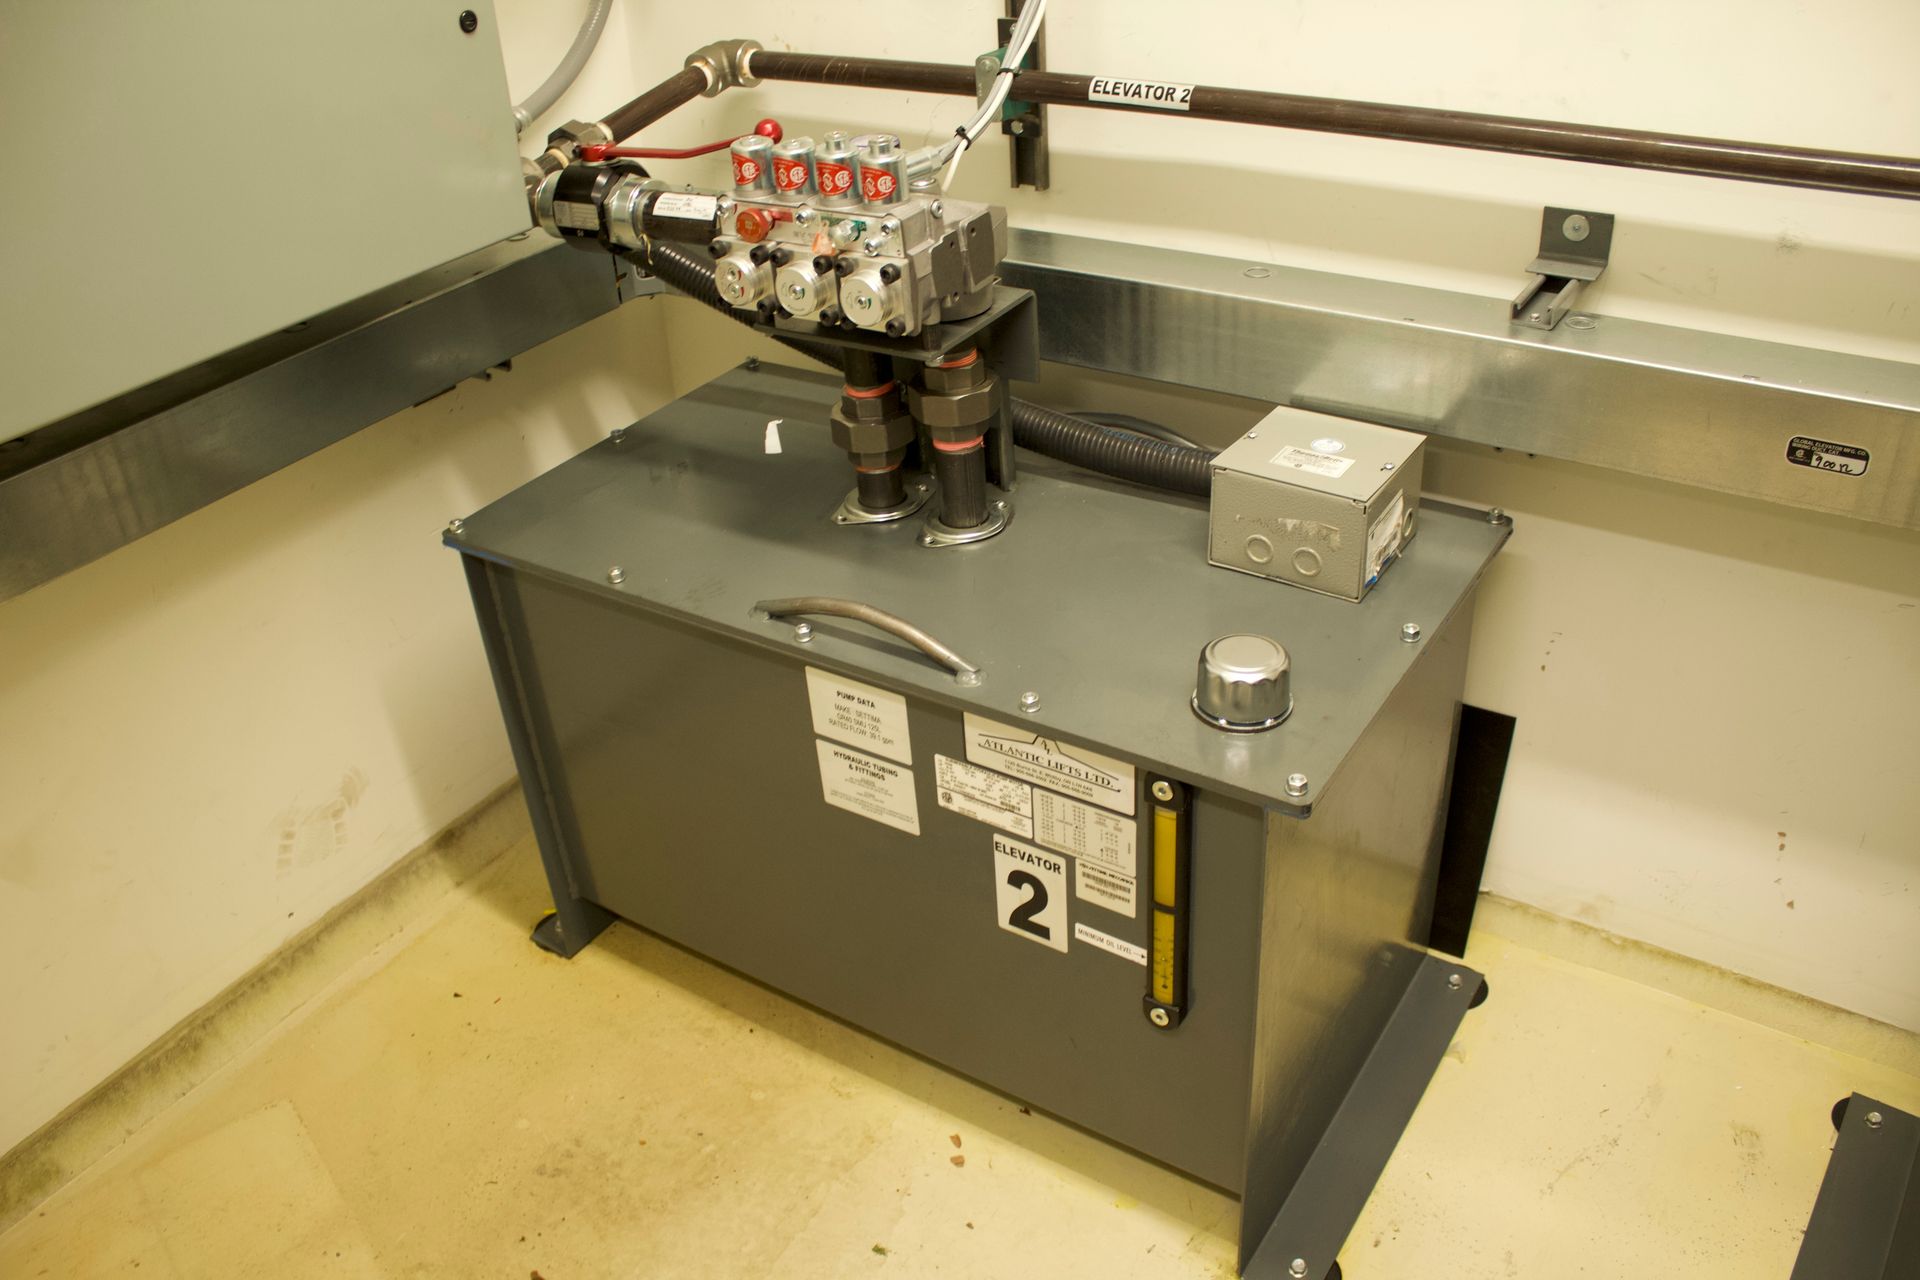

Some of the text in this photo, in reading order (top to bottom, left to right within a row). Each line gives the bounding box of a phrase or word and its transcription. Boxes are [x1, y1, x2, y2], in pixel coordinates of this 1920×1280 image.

[1092, 80, 1191, 103] ELEVATOR 2
[1793, 438, 1814, 447] GLOBAL
[1815, 441, 1842, 451] ELEVATOR
[836, 690, 876, 709] PUMP DATA
[828, 717, 849, 731] RATED
[833, 750, 899, 778] HYDRAULIC TUBING
[855, 766, 886, 782] FITTINGS
[983, 738, 1115, 789] ATLANTIC LIFTS LTD.
[994, 841, 1062, 875] ELEVATOR
[1007, 869, 1051, 941] 2
[1078, 928, 1132, 955] MINIMUM OIL LEVEL
